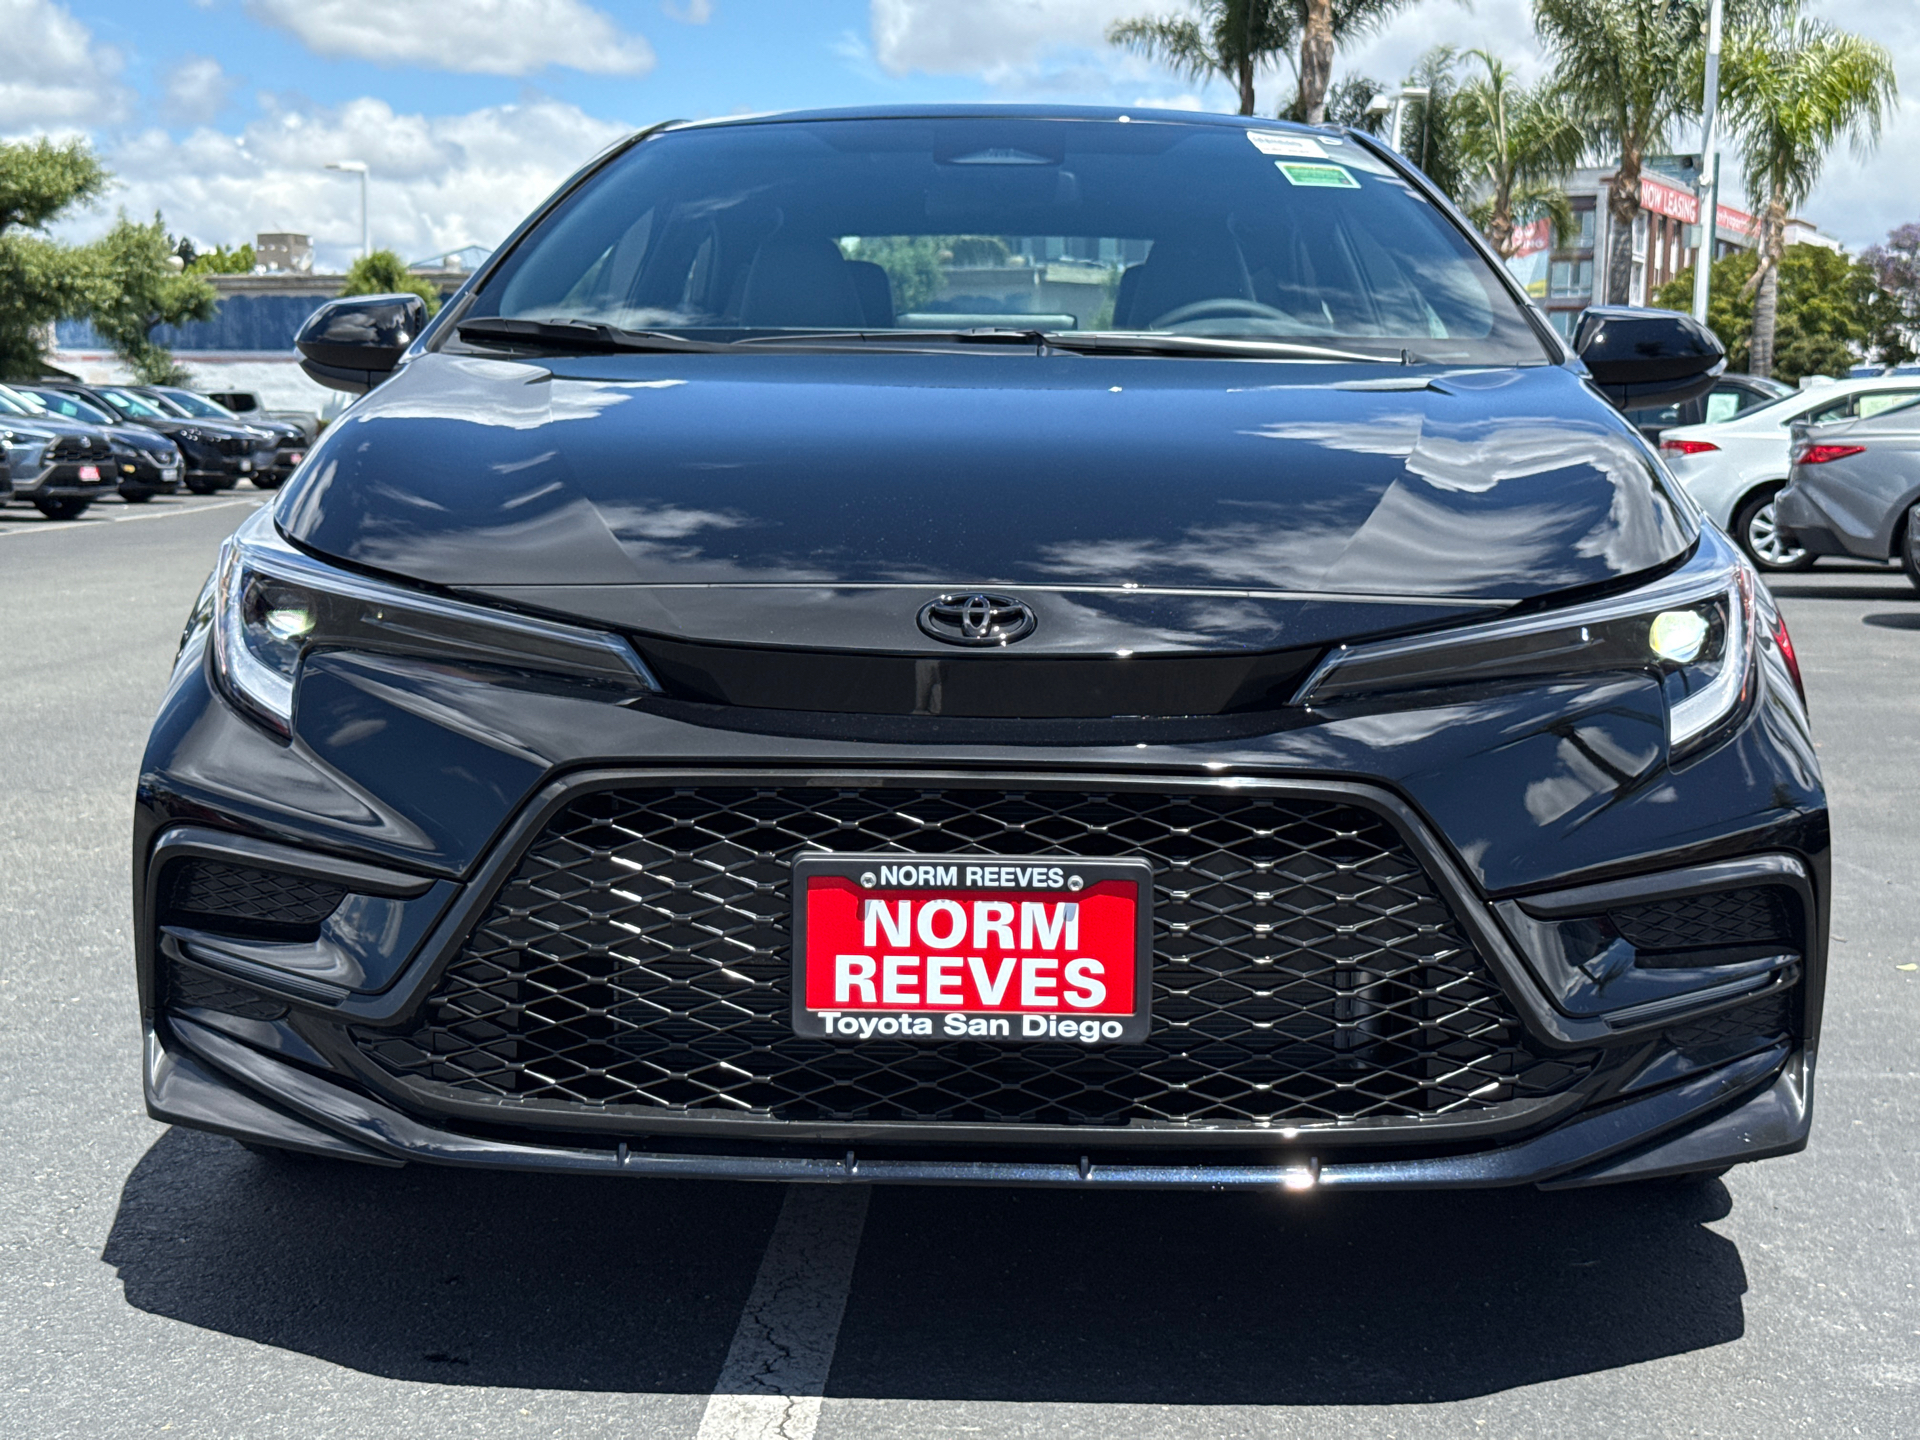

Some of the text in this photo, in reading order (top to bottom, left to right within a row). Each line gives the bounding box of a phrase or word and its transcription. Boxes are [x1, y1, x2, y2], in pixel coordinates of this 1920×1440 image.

[1642, 182, 1697, 223] NOW LEASING
[880, 865, 1065, 888] NORM REEVES
[863, 898, 1080, 951] NORM
[834, 954, 1107, 1008] REEVES
[818, 1011, 1124, 1043] Toyota San Diego
